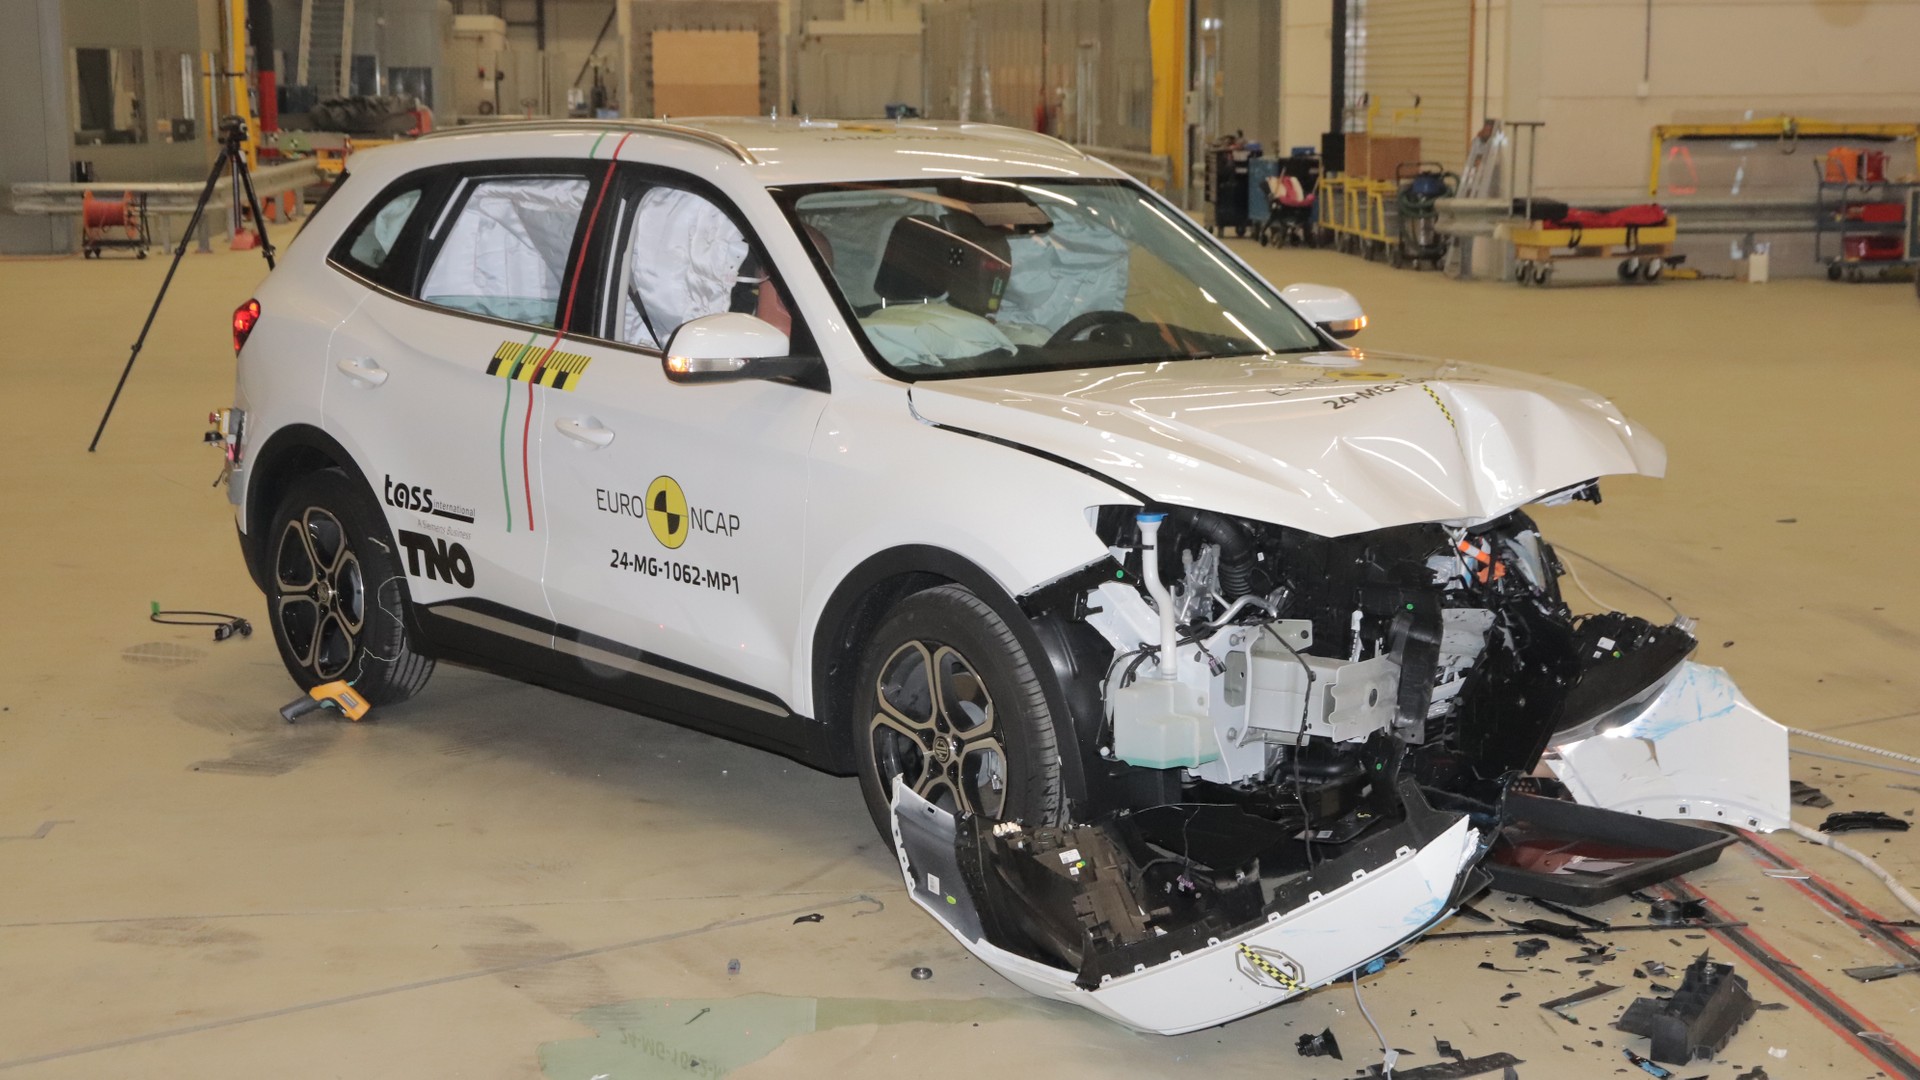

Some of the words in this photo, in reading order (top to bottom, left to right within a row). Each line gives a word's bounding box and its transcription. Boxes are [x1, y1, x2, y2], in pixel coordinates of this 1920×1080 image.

[433, 499, 476, 517] international
[596, 488, 644, 519] EURO
[690, 506, 740, 537] NCAP
[398, 529, 475, 589] TNO
[610, 548, 739, 595] 24-MG-1062-MP1
